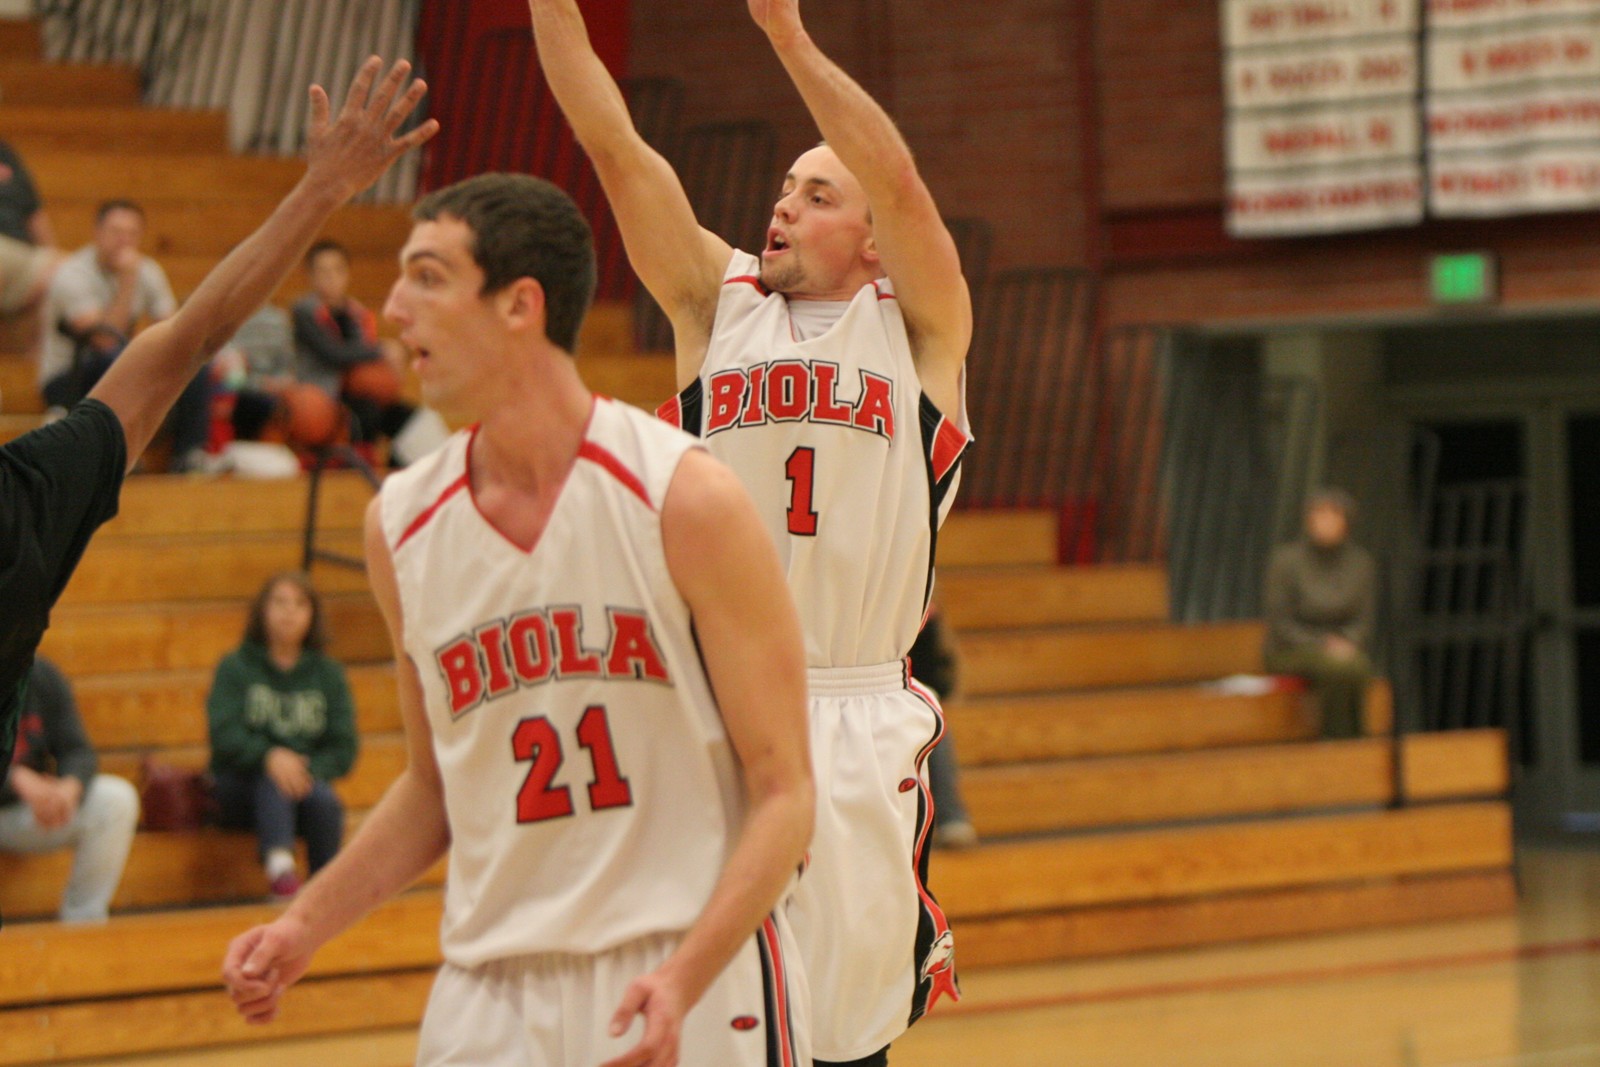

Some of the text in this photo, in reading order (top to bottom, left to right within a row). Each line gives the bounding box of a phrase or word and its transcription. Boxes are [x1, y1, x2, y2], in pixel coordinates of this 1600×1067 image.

[706, 359, 895, 447] BIOLA
[785, 446, 818, 536] 1
[434, 604, 675, 722] BIOLA
[511, 703, 633, 824] 21
